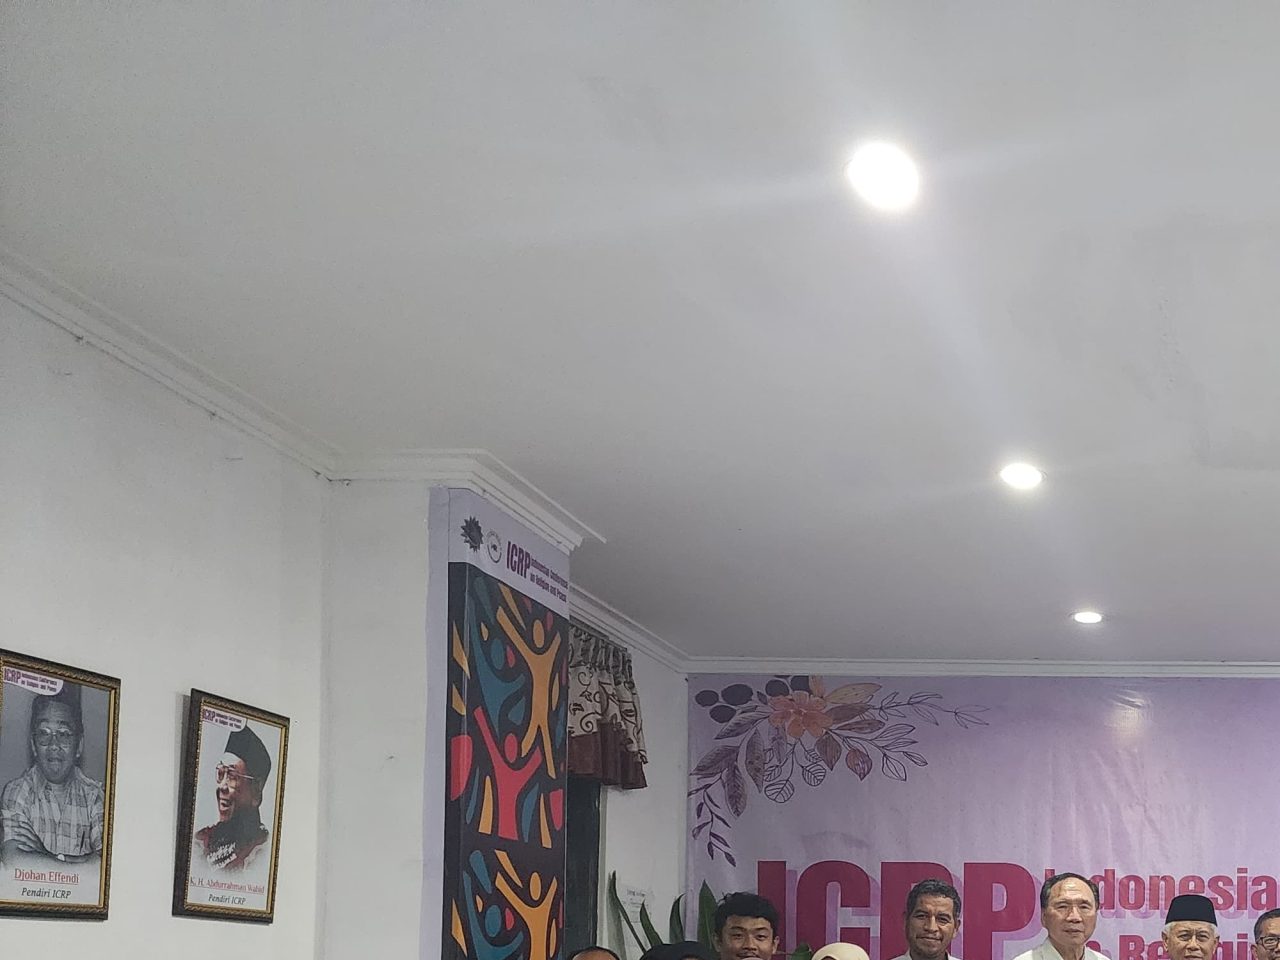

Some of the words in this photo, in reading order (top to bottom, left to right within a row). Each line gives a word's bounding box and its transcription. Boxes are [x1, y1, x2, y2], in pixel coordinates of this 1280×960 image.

[506, 541, 531, 579] ICRP
[4, 667, 20, 684] ICRP
[14, 867, 46, 881] Djohan
[48, 871, 79, 884] Effendi
[21, 887, 51, 898] Pendiri
[52, 889, 71, 899] ICRP
[207, 879, 247, 892] Abdurrahman
[247, 884, 265, 894] Wahid
[208, 893, 230, 904] Pendiri
[231, 896, 246, 905] ICRP
